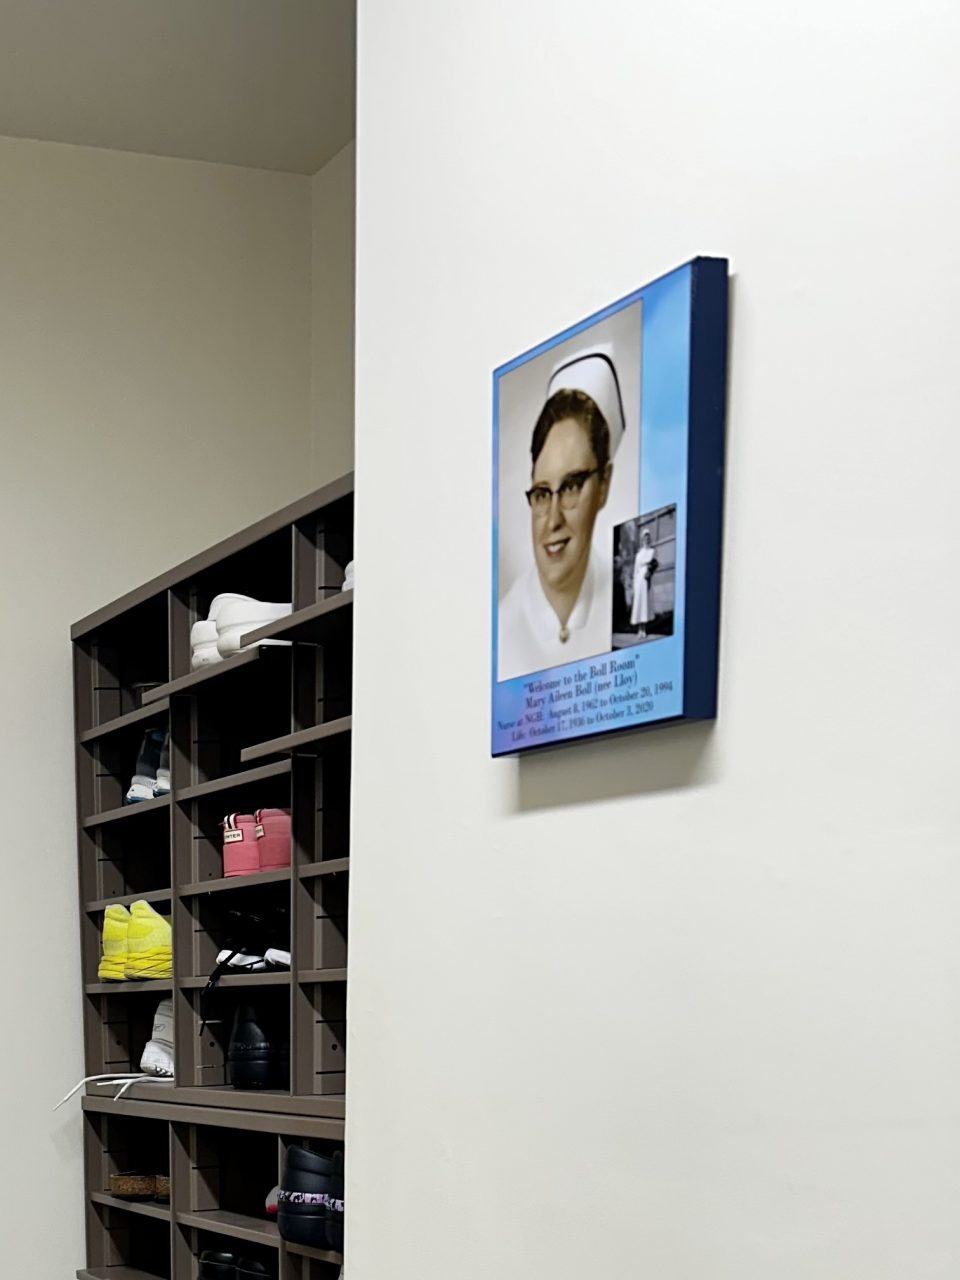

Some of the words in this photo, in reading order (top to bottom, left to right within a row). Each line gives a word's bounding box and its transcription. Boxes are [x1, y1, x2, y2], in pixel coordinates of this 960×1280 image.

[524, 679, 560, 694] "Welcome
[563, 675, 572, 684] to
[574, 671, 587, 682] the
[590, 665, 607, 679] Boll
[610, 654, 640, 673] Room"
[526, 697, 544, 710] Mary
[549, 690, 572, 703] Aileen
[575, 684, 592, 697] Boll
[614, 672, 637, 689] Lloy)
[529, 724, 556, 737] October
[587, 714, 594, 725] to
[597, 708, 624, 724] October
[636, 702, 654, 715] 2020
[549, 706, 571, 721] August
[600, 697, 607, 707] to
[609, 690, 638, 704] October
